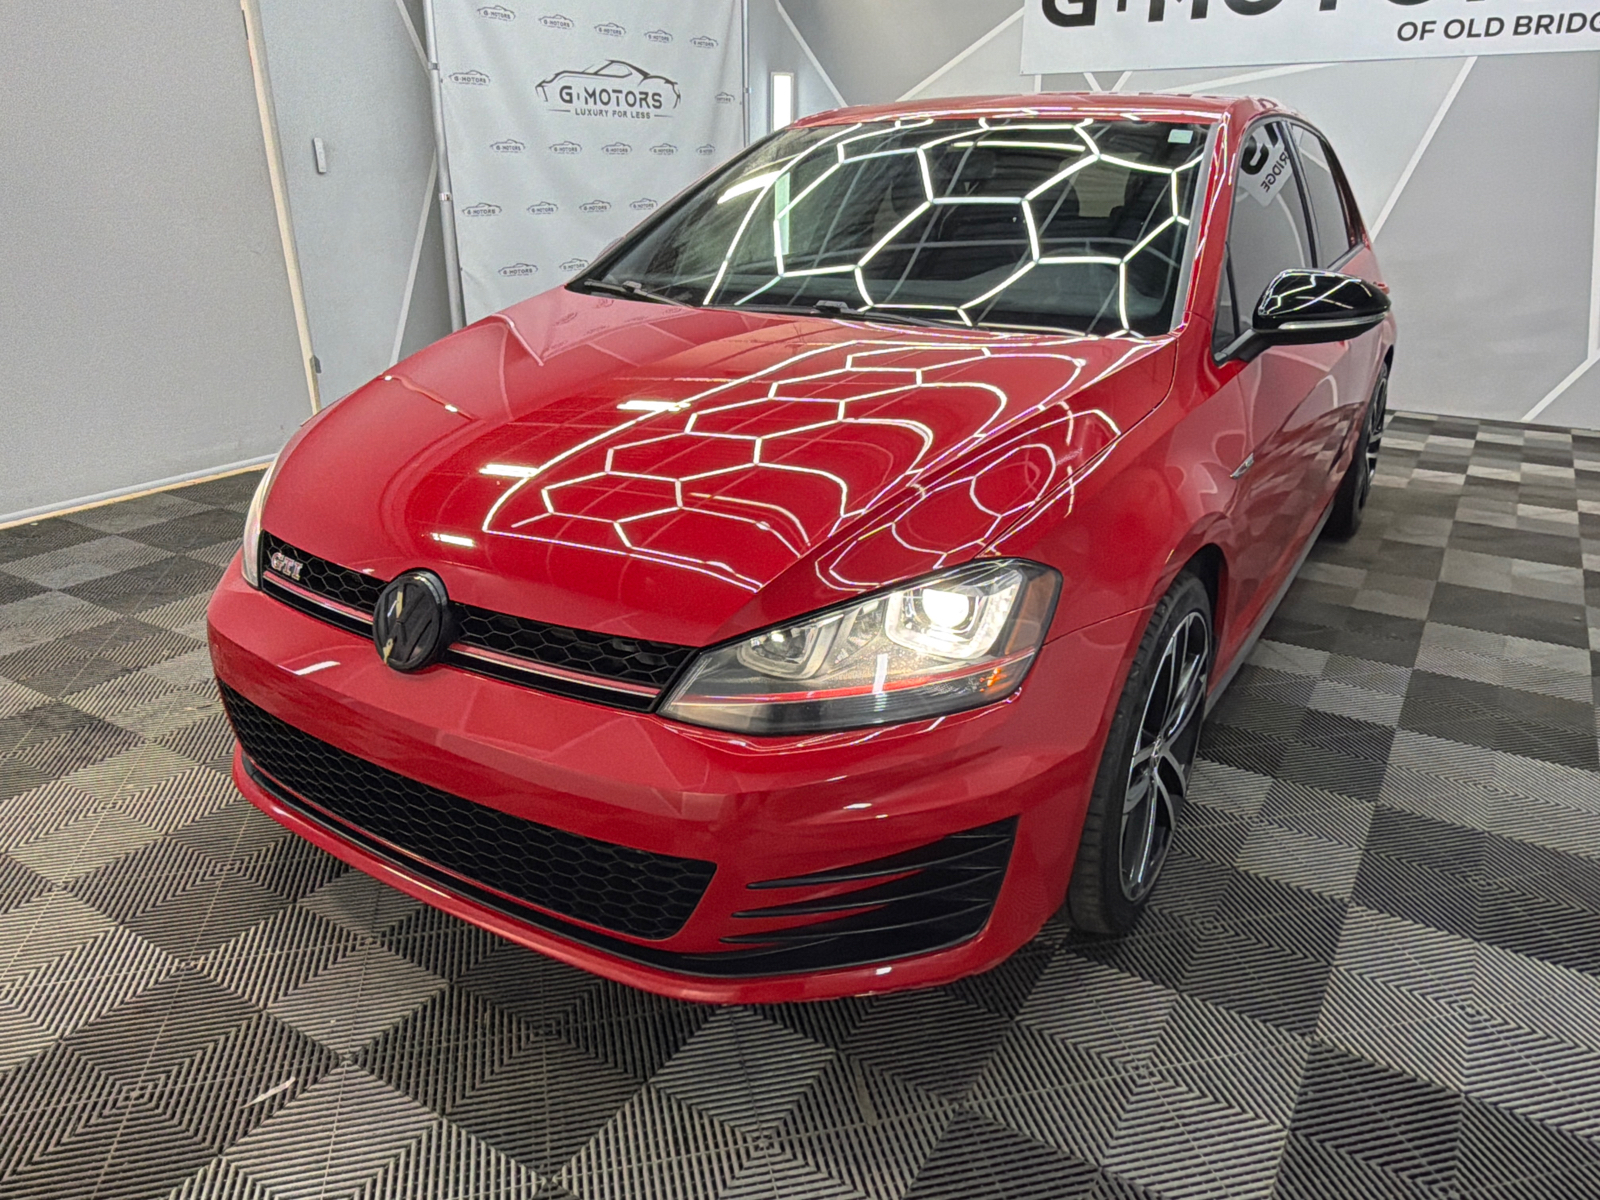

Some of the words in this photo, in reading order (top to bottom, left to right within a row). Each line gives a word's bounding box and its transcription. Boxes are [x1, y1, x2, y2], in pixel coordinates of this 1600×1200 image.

[1396, 20, 1437, 42] OF
[1443, 17, 1505, 40] OLD
[574, 108, 609, 117] LUXURY
[612, 109, 628, 118] FOR
[630, 110, 651, 119] LESS
[270, 552, 304, 581] GTI
